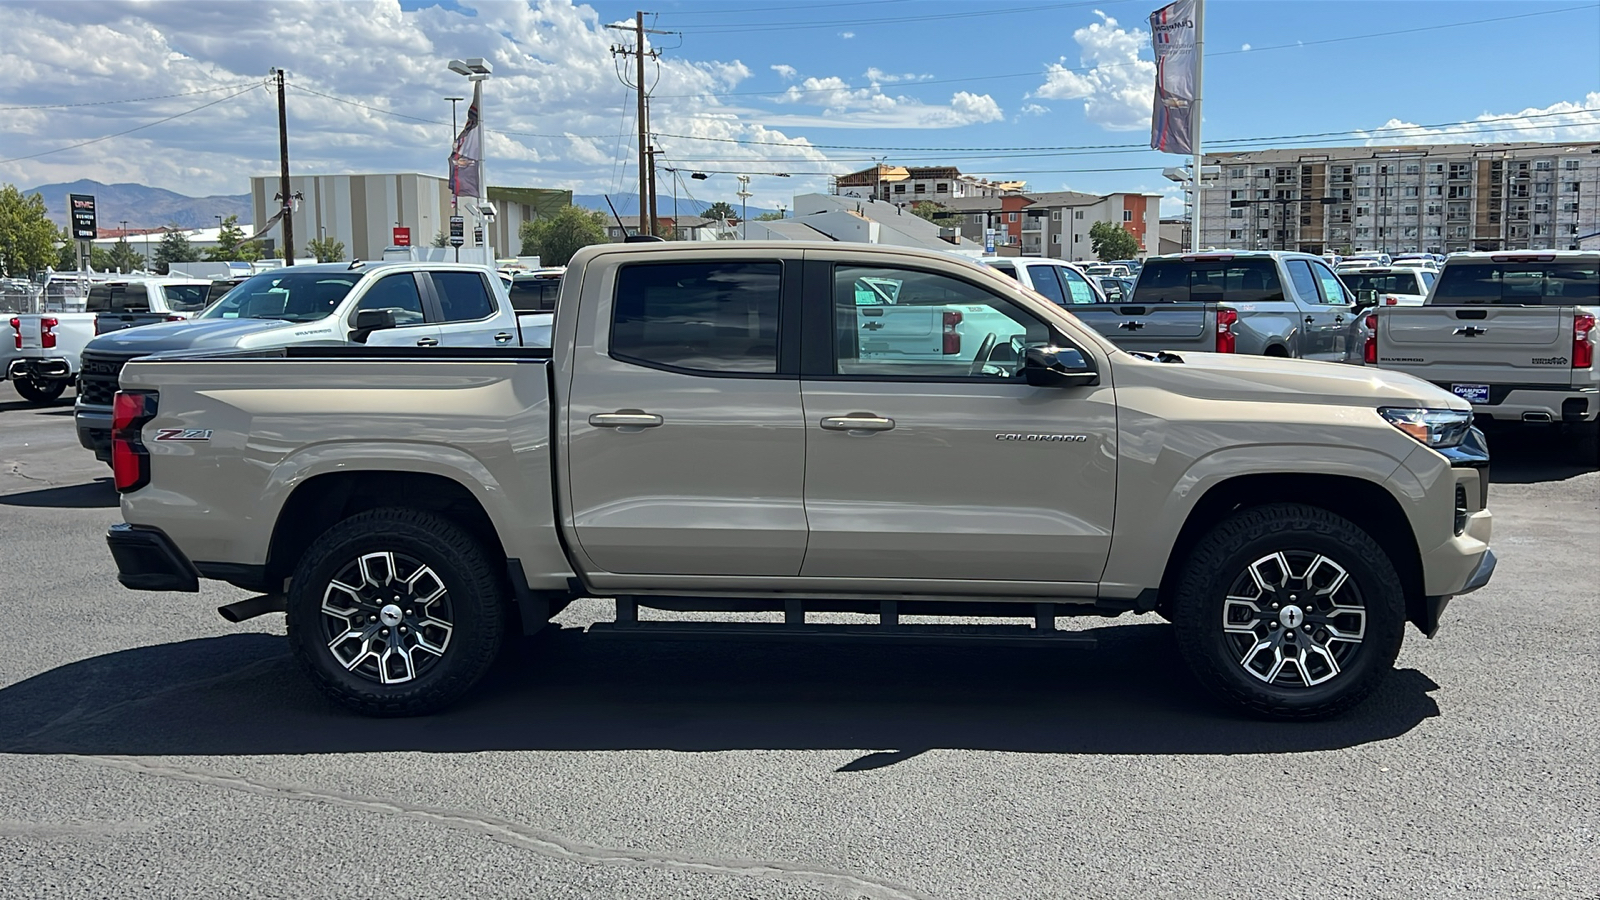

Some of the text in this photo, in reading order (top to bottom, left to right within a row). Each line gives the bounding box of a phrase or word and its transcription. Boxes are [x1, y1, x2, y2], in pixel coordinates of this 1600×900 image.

[74, 200, 94, 209] GMC
[1454, 386, 1488, 395] CHAMPION
[152, 428, 214, 442] Z71
[995, 433, 1087, 443] COLORADO
